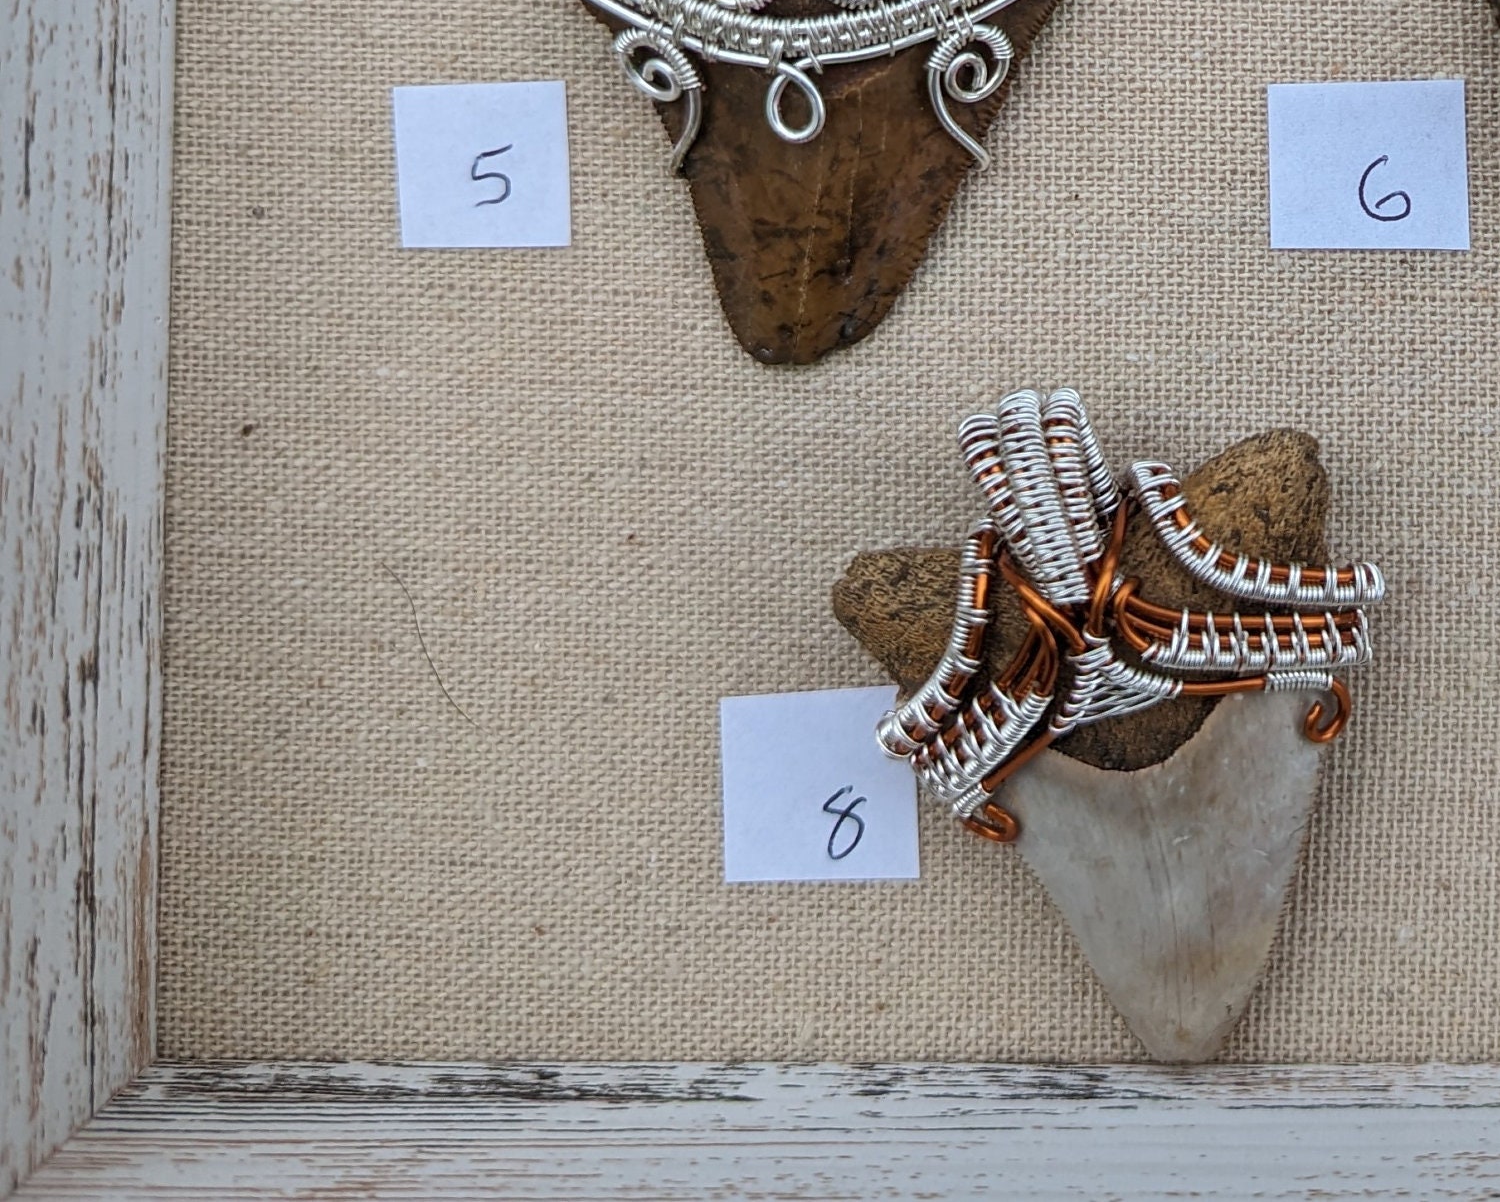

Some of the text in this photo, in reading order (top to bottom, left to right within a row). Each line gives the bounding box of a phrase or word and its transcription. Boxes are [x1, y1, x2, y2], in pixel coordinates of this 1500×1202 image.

[470, 143, 513, 207] 5
[1358, 154, 1412, 223] 6
[822, 787, 868, 861] 8
